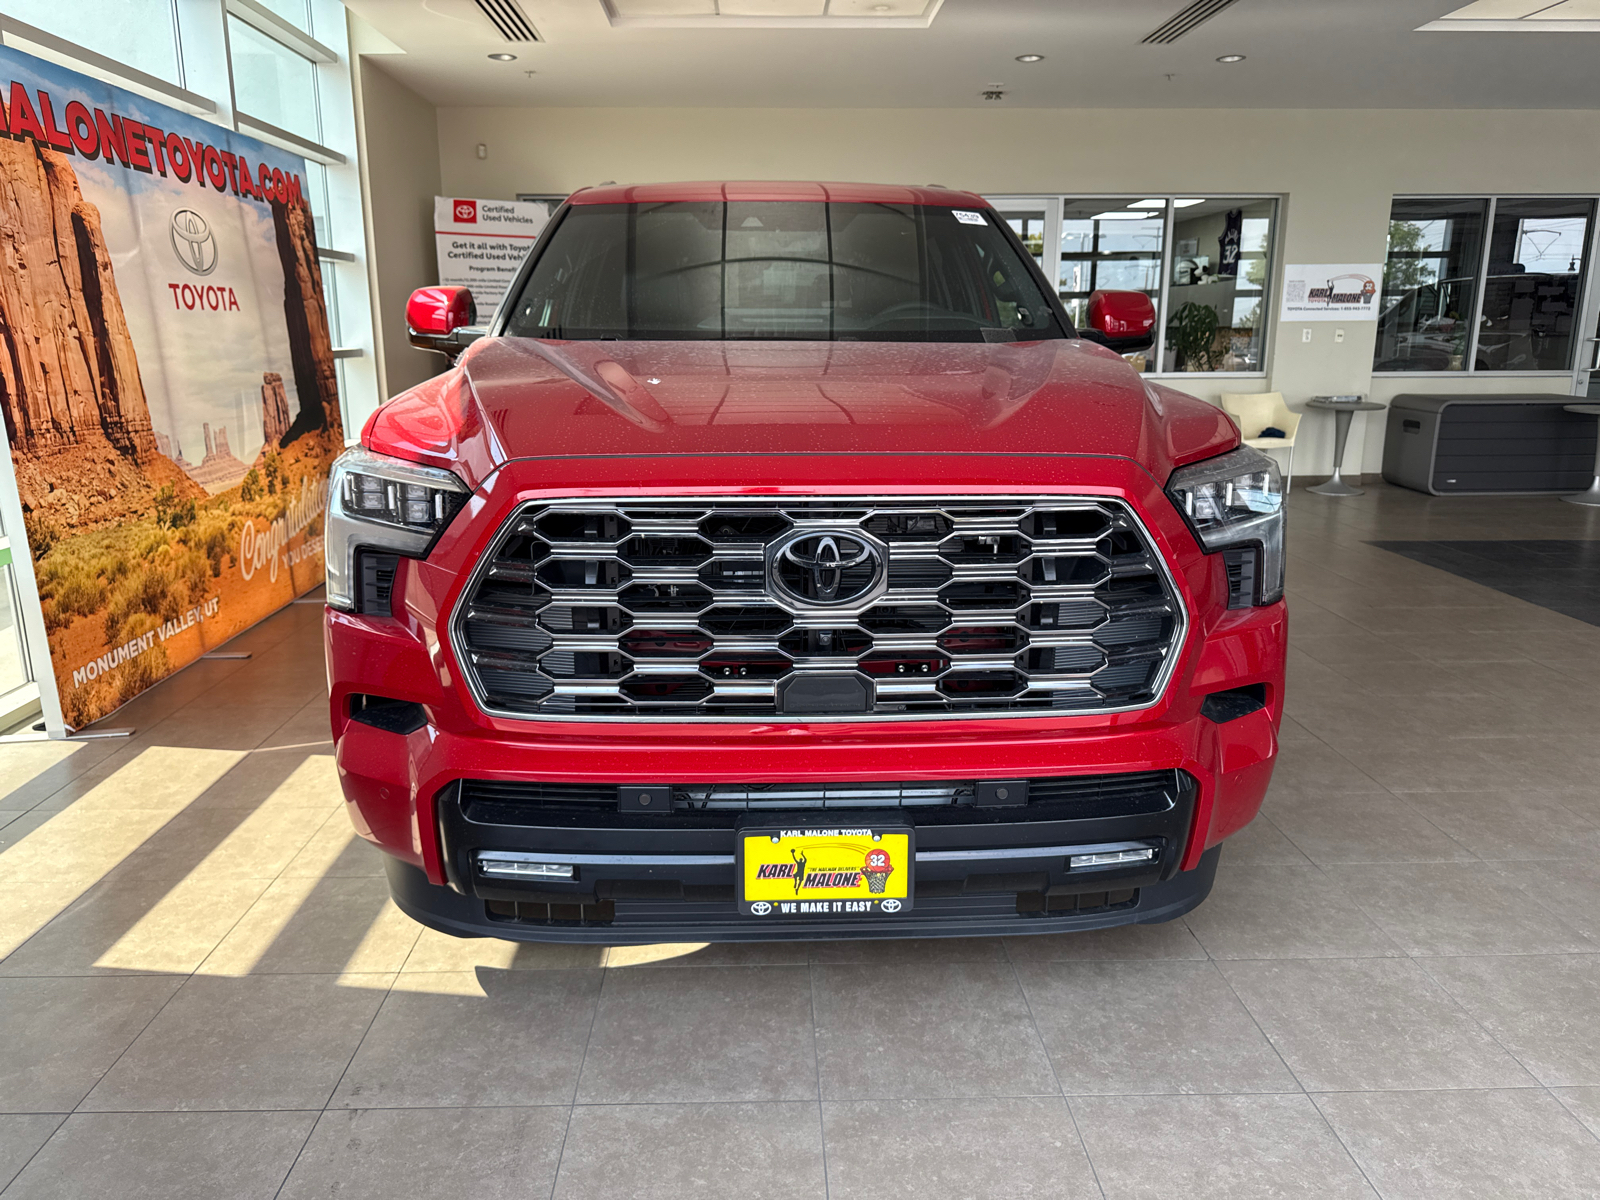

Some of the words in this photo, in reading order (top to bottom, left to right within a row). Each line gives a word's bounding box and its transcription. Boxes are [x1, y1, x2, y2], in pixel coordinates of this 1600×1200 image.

[482, 205, 514, 214] Certified
[482, 214, 502, 222] Used
[503, 215, 533, 224] Vehicles
[452, 241, 468, 250] Get
[469, 242, 476, 250] it
[477, 242, 488, 250] all
[489, 243, 507, 251] with
[447, 251, 484, 260] Certified
[485, 253, 506, 261] Used
[1223, 245, 1238, 264] 32
[469, 265, 496, 273] Program
[168, 283, 240, 312] TOYOTA
[1308, 288, 1329, 298] KARL
[1330, 293, 1362, 303] MALONE
[282, 548, 301, 569] YOU
[72, 630, 155, 689] MONUMENT
[156, 605, 204, 643] VALLEY,
[204, 597, 219, 618] UT
[780, 830, 803, 838] KARL
[805, 829, 839, 837] MALONE
[840, 828, 872, 837] TOYOTA
[870, 854, 885, 867] 32
[756, 863, 796, 880] KARL
[802, 872, 861, 889] MALONE
[781, 902, 797, 913] WE
[801, 902, 830, 913] MAKE
[833, 902, 842, 912] IT
[845, 901, 872, 912] EASY
